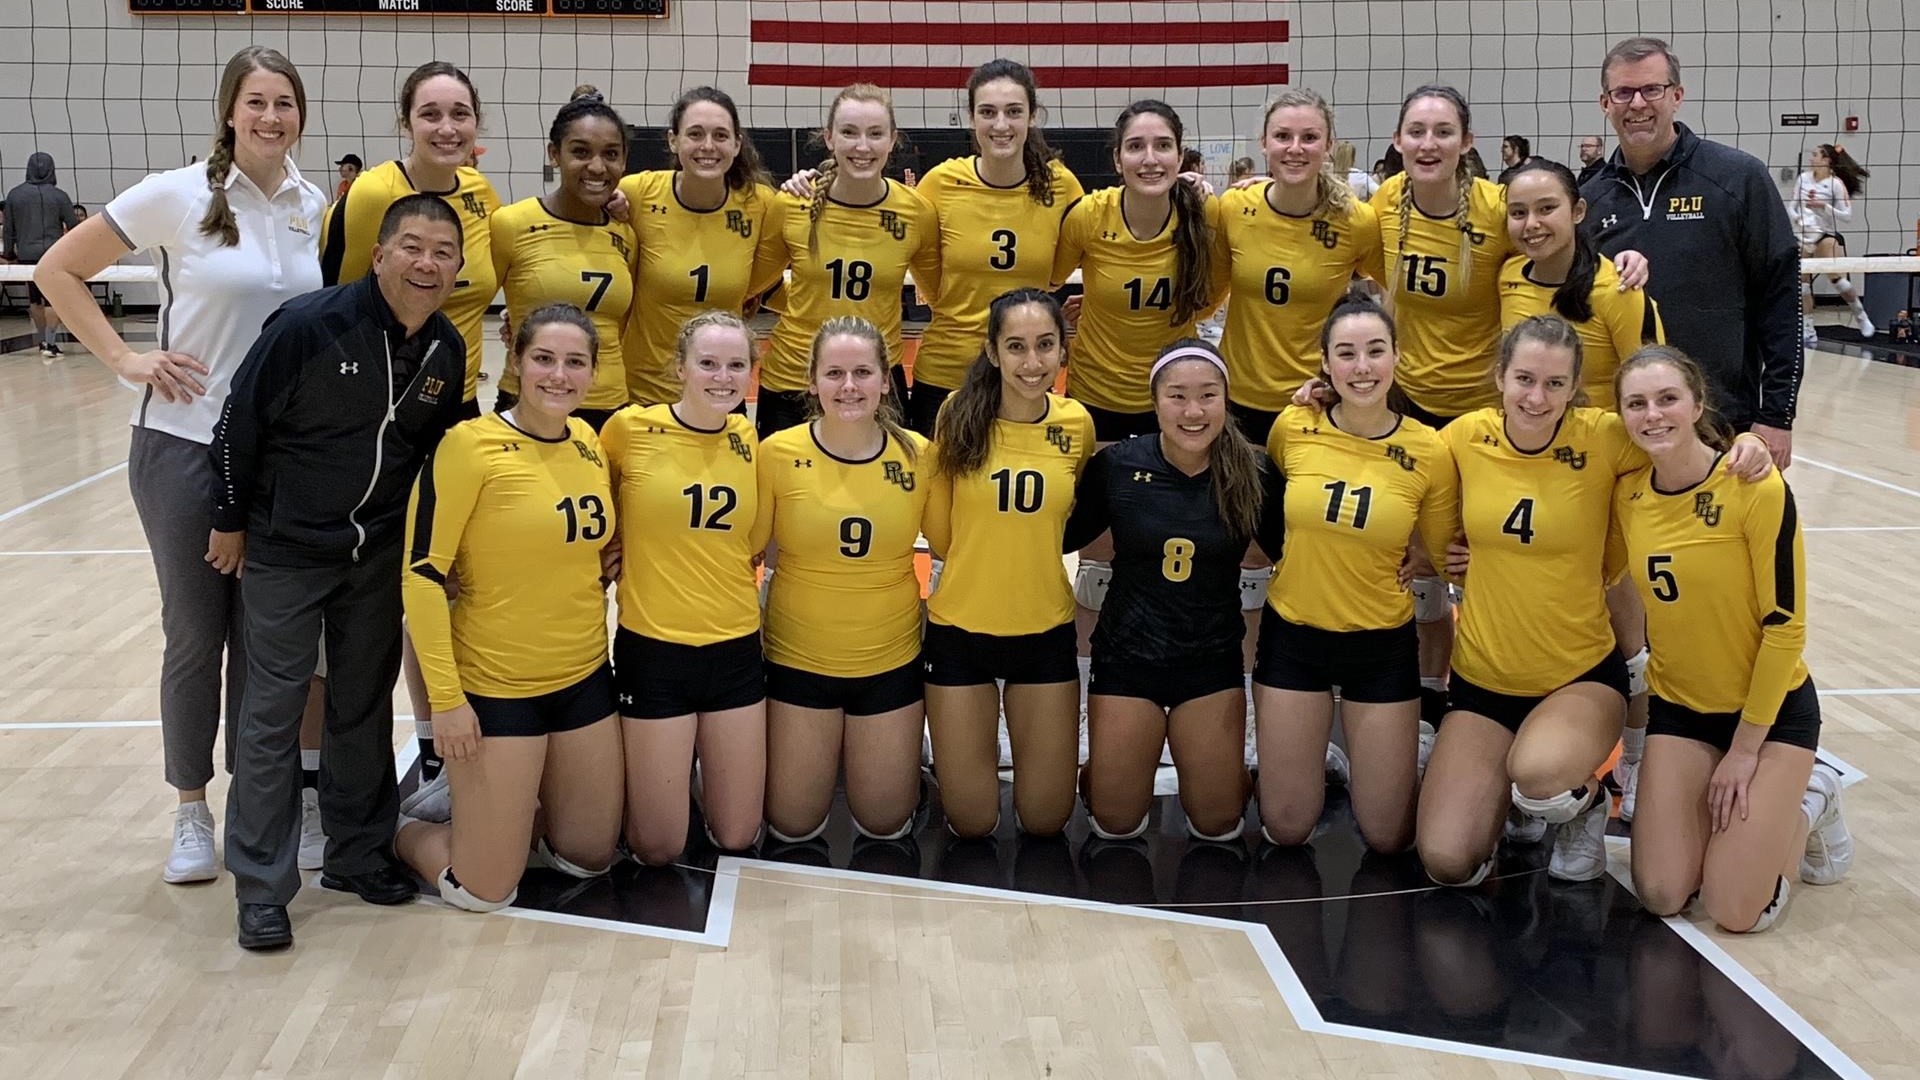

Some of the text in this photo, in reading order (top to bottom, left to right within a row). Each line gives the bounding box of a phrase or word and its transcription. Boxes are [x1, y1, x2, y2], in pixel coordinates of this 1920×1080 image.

[266, 0, 304, 9] SCORE
[379, 0, 419, 10] MATCH
[496, 0, 533, 11] SCORE
[1668, 196, 1703, 212] PLU
[989, 228, 1018, 271] 3
[580, 271, 613, 312] 7
[688, 264, 709, 303] 1
[824, 258, 874, 301] 18
[1122, 276, 1173, 311] 14
[1264, 266, 1292, 306] 6
[1402, 253, 1448, 298] 15
[422, 376, 445, 395] PLU
[682, 483, 738, 531] 12
[990, 467, 1045, 514] 10
[1323, 480, 1373, 531] 11
[555, 494, 608, 543] 13
[839, 516, 873, 558] 9
[1502, 497, 1536, 545] 4
[1162, 537, 1196, 582] 8
[1647, 555, 1680, 604] 5
